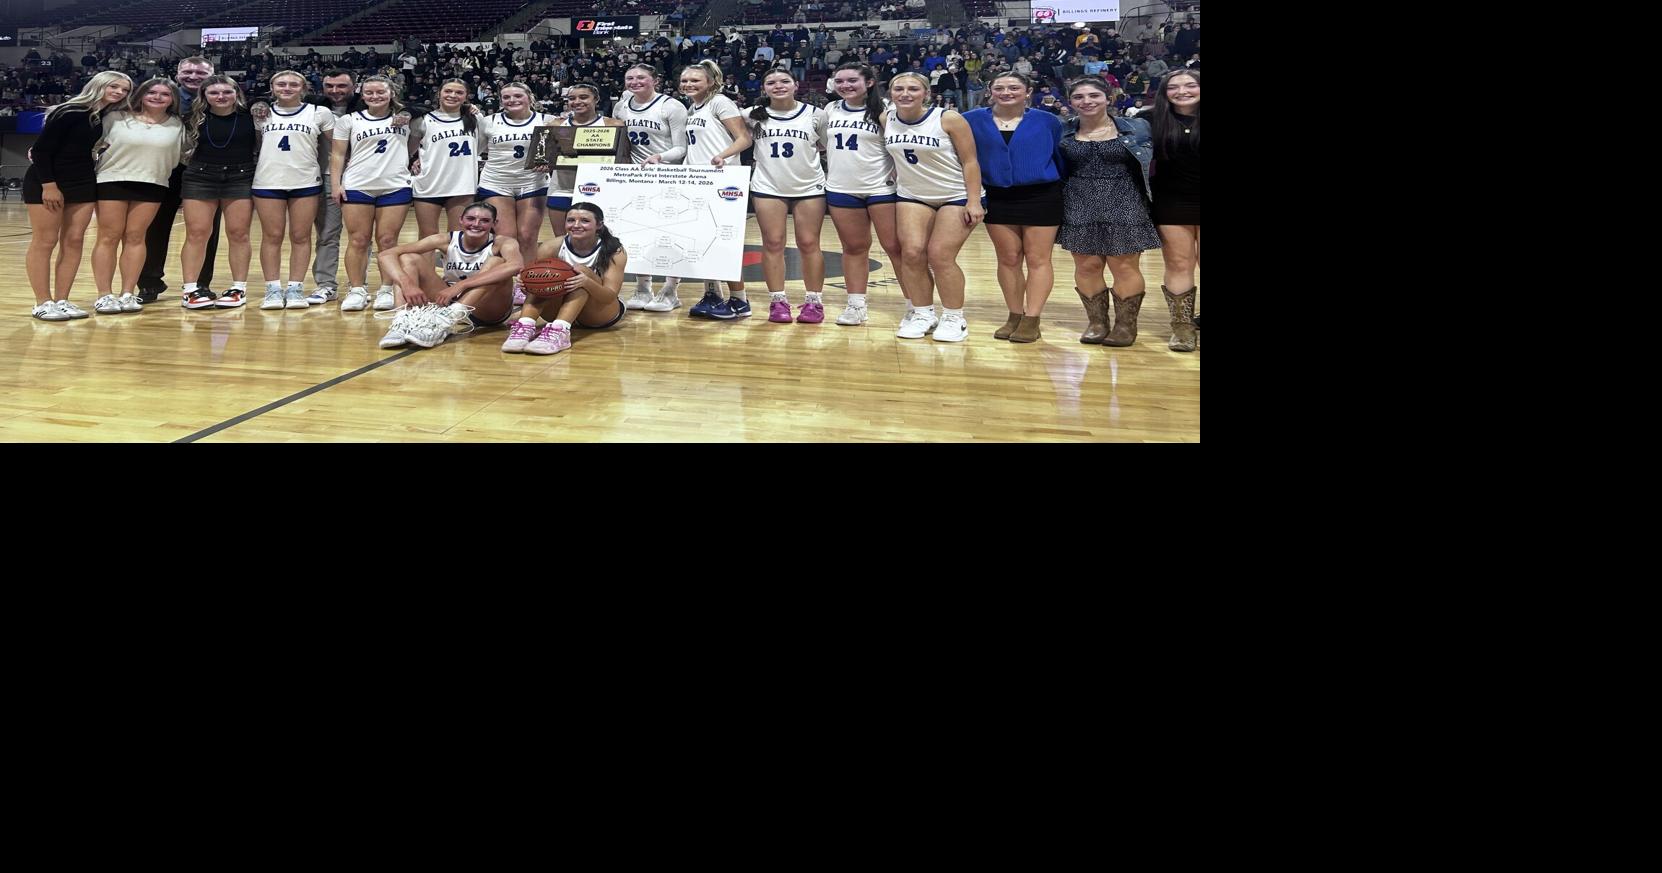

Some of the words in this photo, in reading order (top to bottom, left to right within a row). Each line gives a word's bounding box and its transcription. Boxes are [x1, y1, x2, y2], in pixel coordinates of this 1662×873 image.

[828, 120, 880, 134] ALLATIN
[432, 129, 473, 142] GALLA
[629, 131, 650, 146] 22
[835, 133, 858, 150] 14
[278, 136, 290, 152] 4
[374, 139, 388, 154] 2
[448, 140, 472, 157] 24
[513, 145, 525, 158] 3
[770, 142, 794, 158] 13
[904, 149, 918, 164] 5
